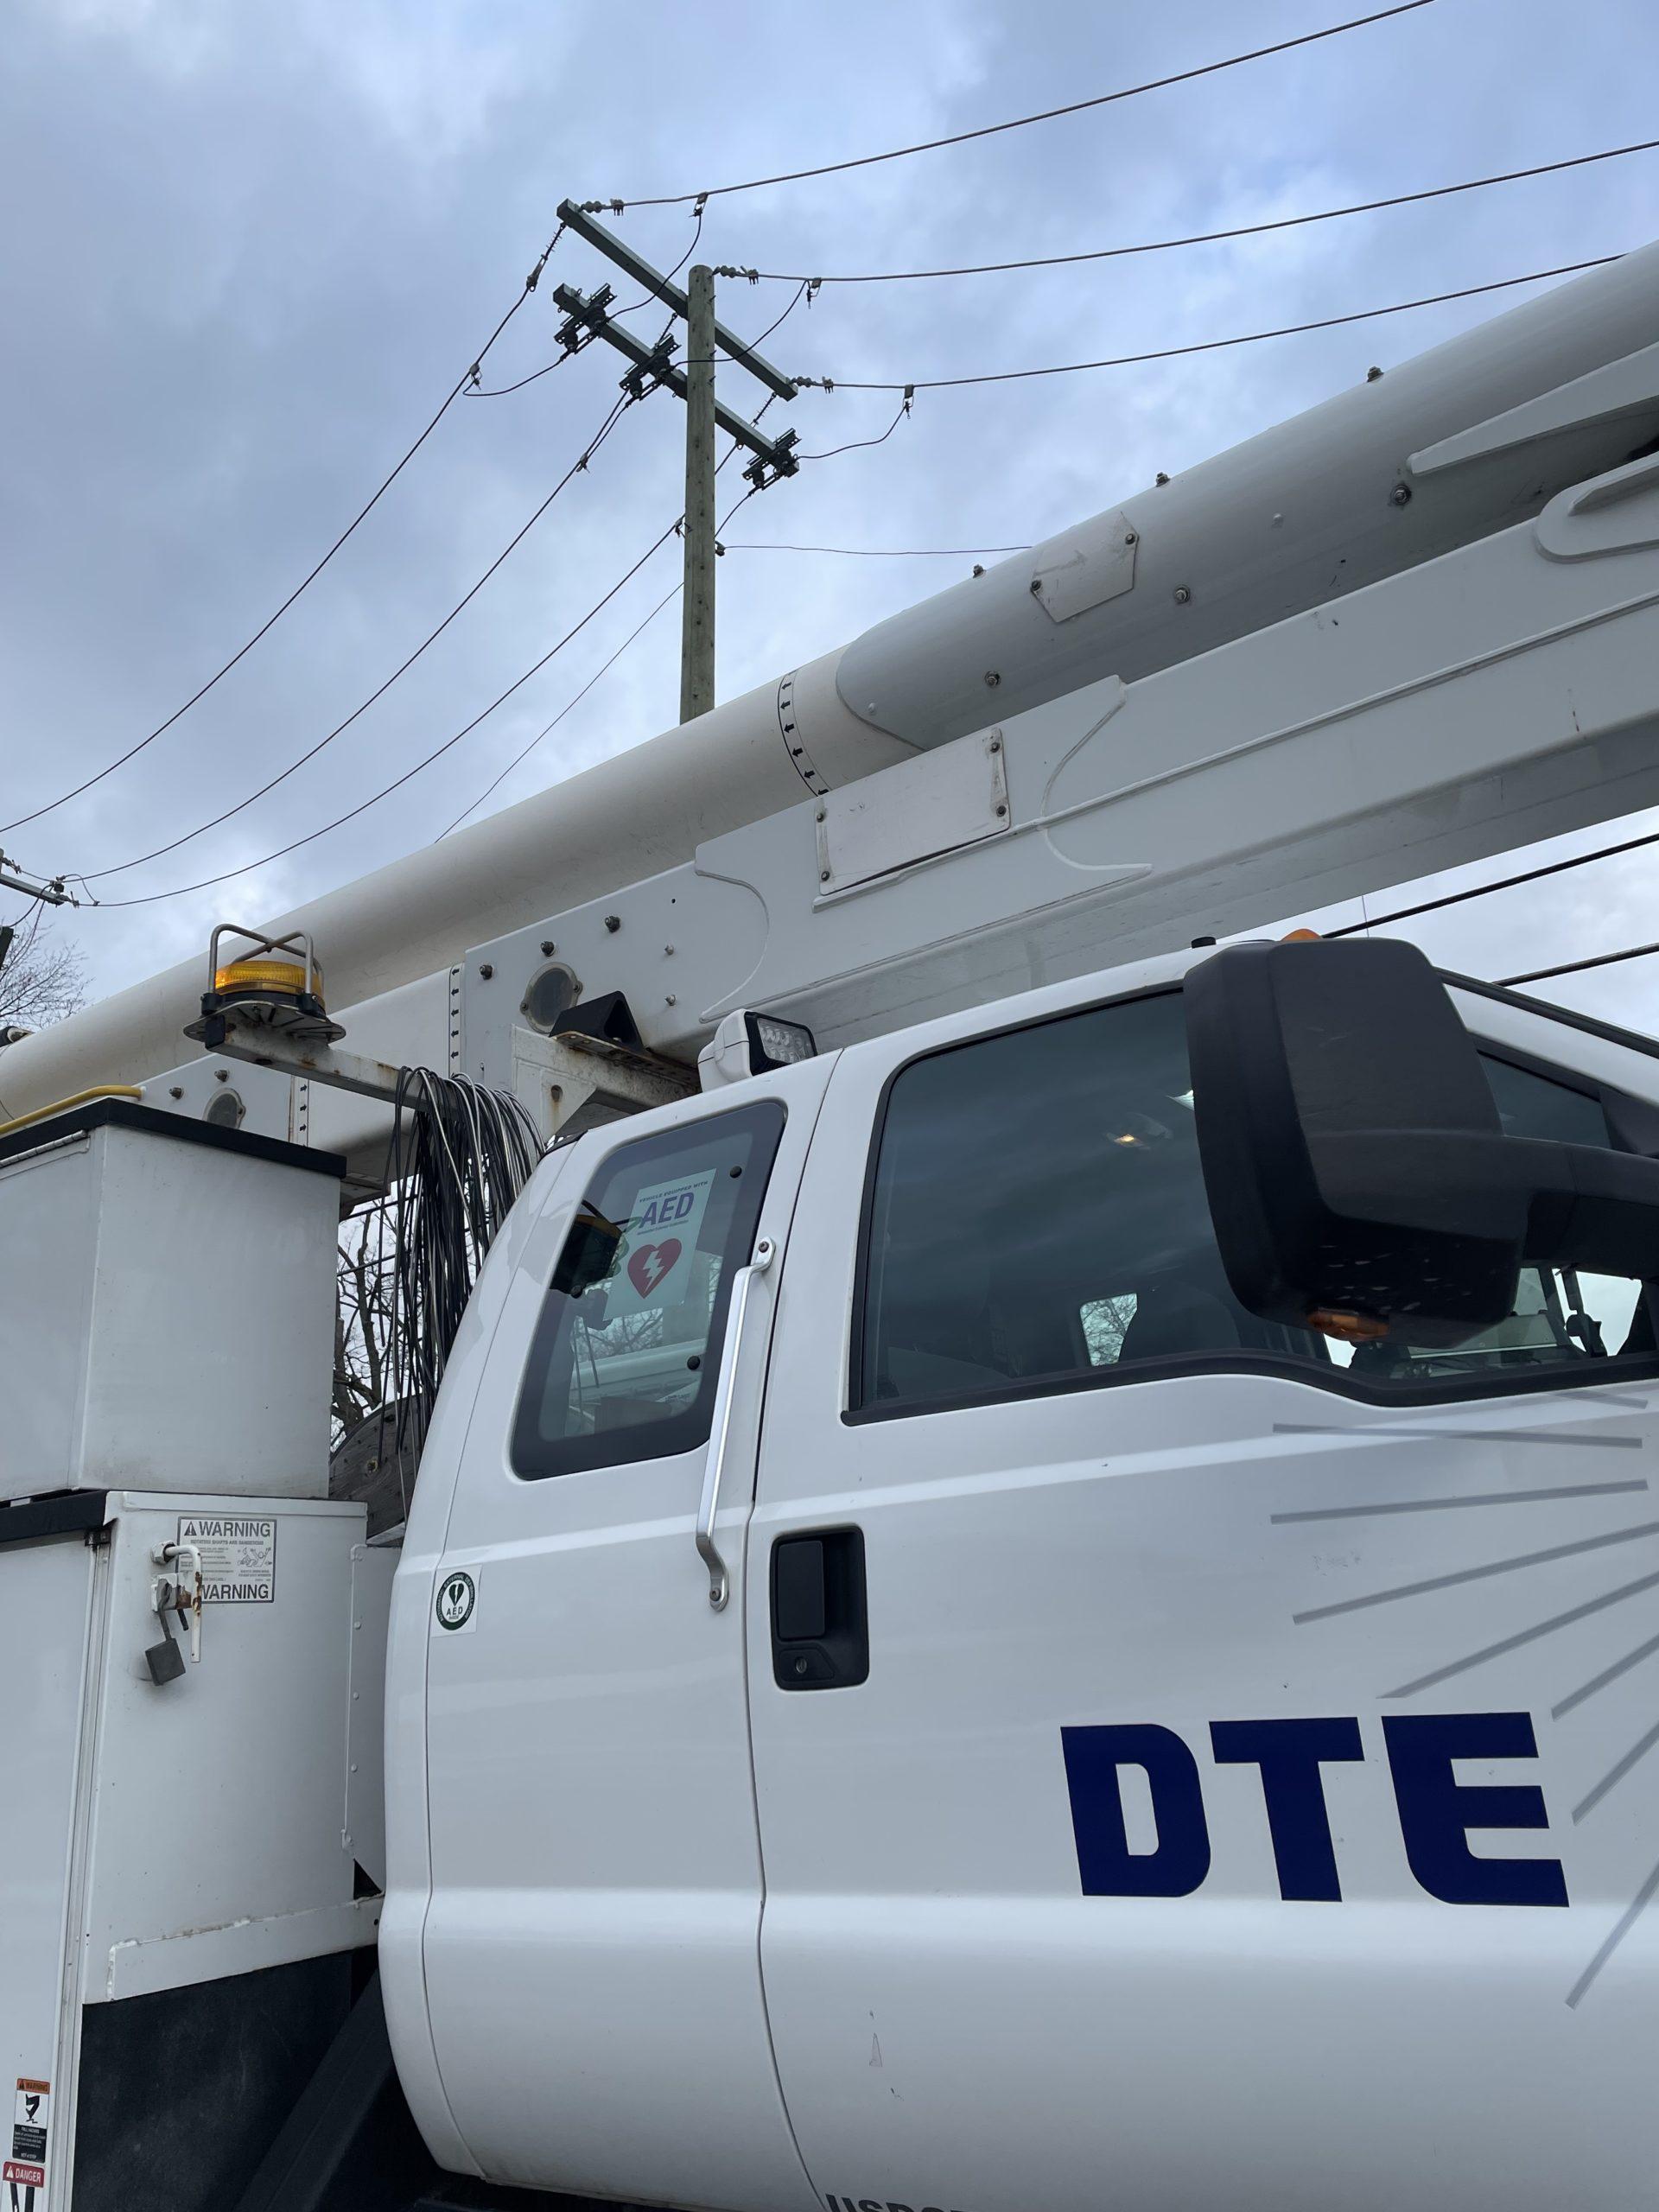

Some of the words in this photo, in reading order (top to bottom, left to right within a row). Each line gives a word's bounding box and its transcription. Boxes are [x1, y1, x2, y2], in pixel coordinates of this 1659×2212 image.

[639, 1192, 695, 1229] AED
[199, 1521, 270, 1537] WARNING
[446, 1606, 463, 1616] AED
[1059, 1712, 1570, 1908] DTE
[26, 2082, 48, 2092] WARNING
[16, 2168, 41, 2183] DANGER
